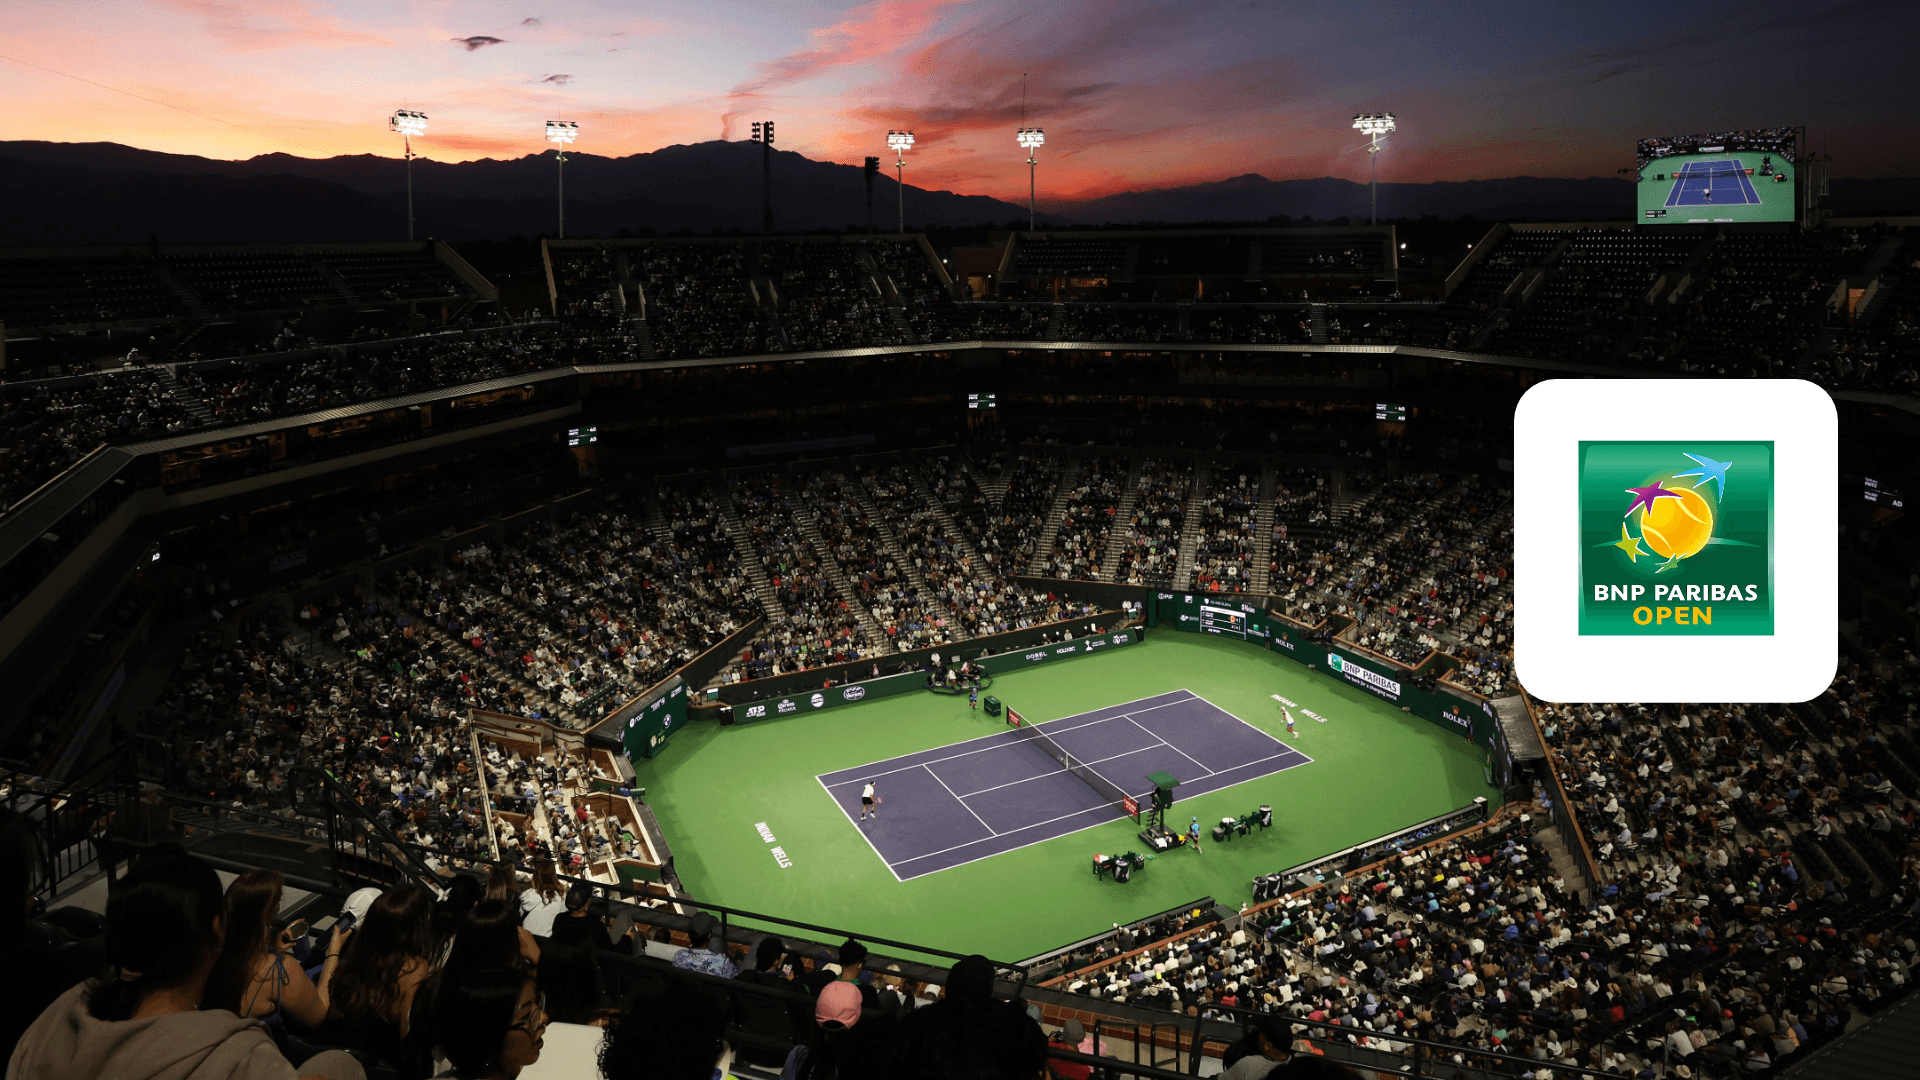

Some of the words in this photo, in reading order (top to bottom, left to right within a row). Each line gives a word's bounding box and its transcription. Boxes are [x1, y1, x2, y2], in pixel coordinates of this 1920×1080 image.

[1275, 637, 1294, 650] ROLEX
[1026, 651, 1047, 660] DOBEL
[1344, 662, 1360, 675] BNP
[1363, 670, 1397, 692] PARIBAS
[747, 705, 766, 713] ATP
[1443, 711, 1468, 728] ROLEX
[754, 822, 776, 843] INDIAN
[770, 846, 792, 868] WELLS
